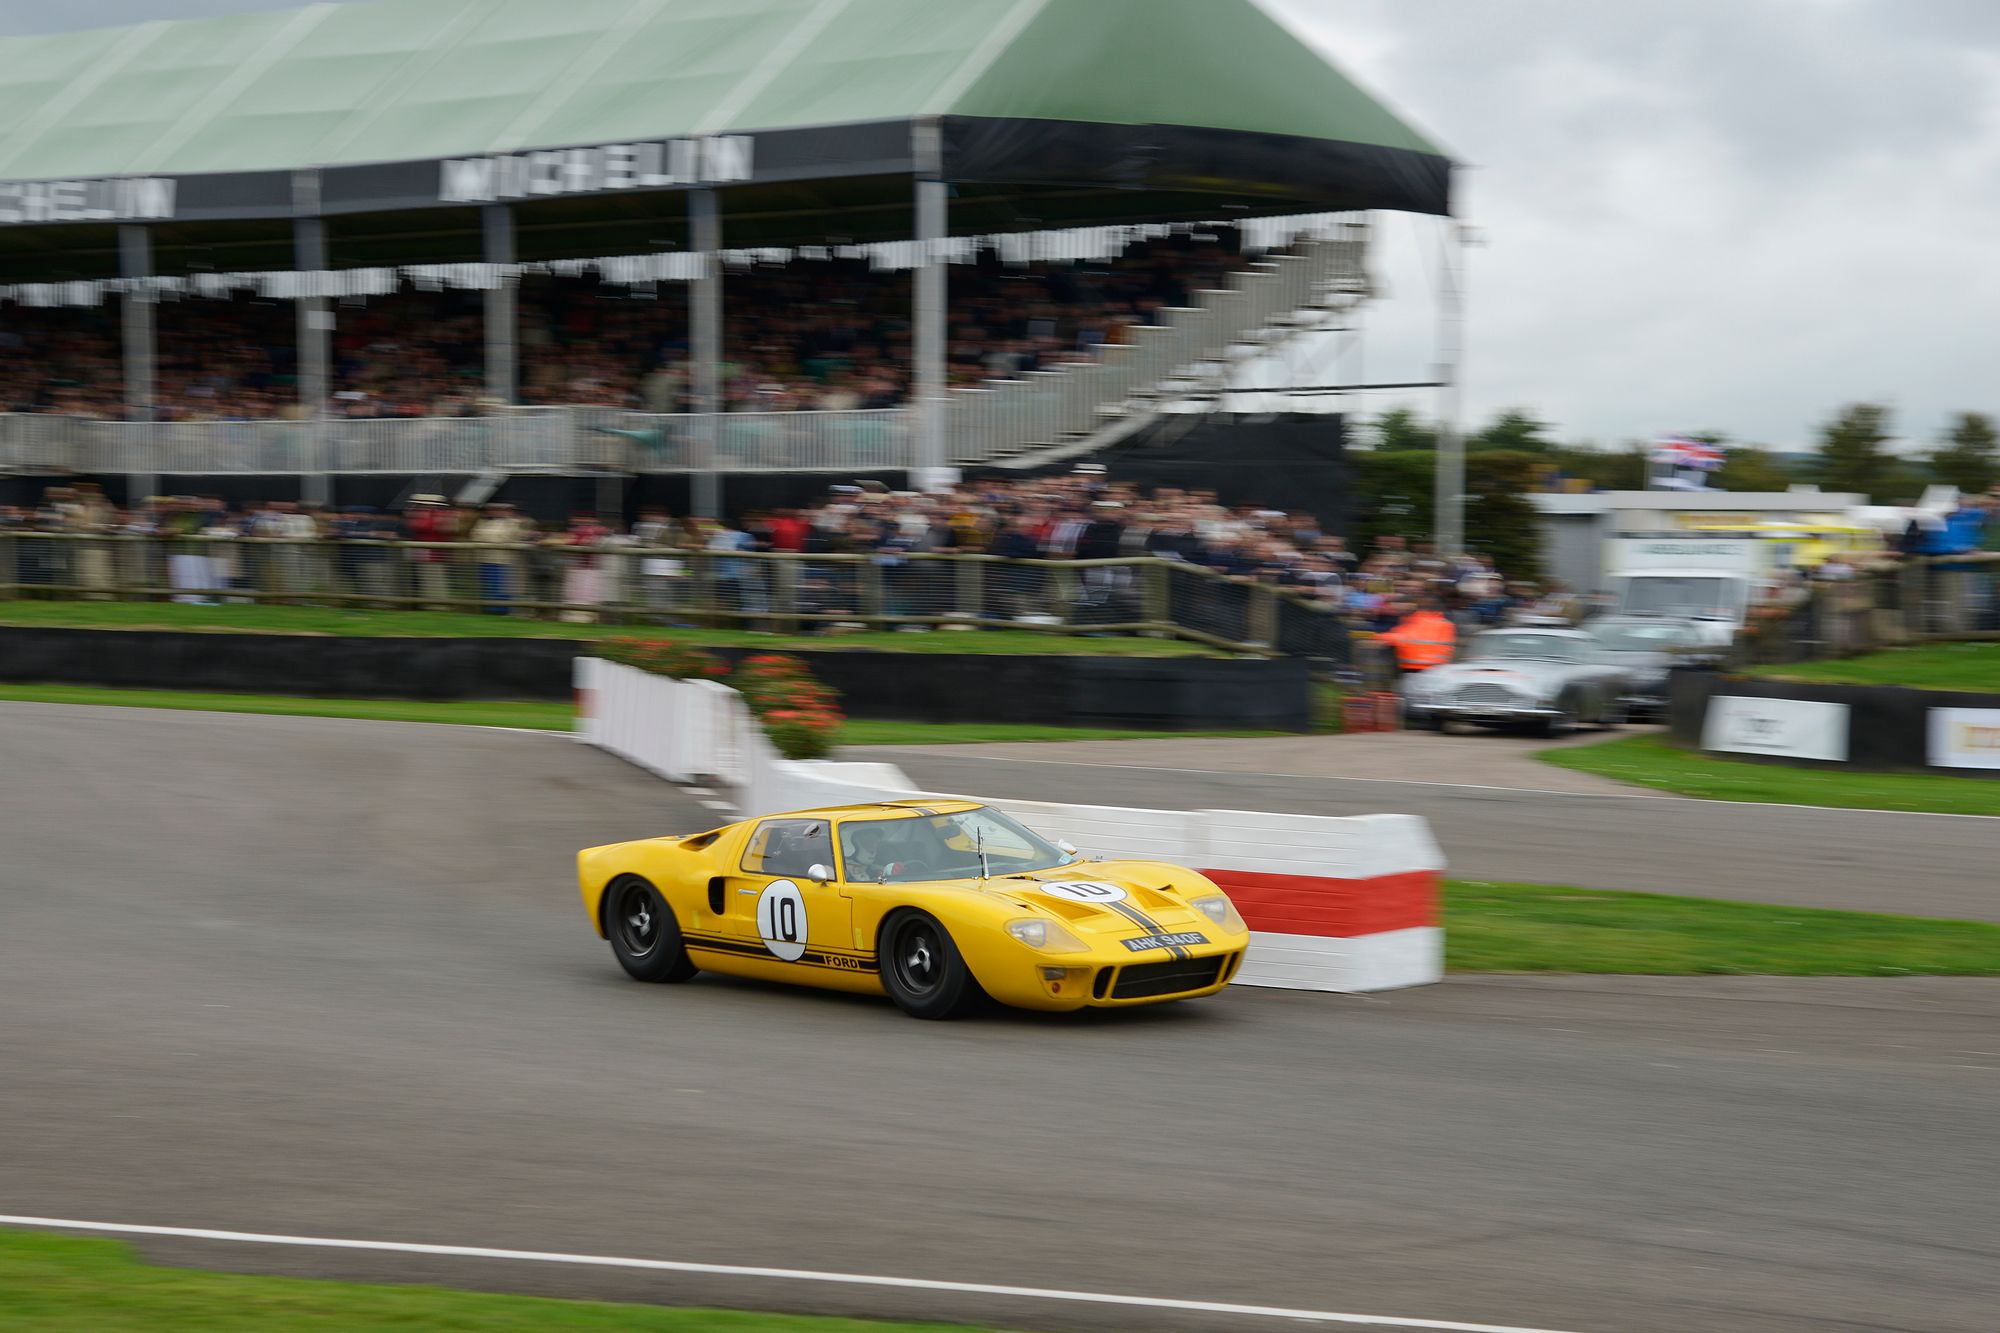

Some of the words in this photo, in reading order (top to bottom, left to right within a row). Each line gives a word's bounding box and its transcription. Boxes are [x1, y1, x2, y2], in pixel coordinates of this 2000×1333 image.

[440, 135, 754, 202] MICHELIN
[1056, 883, 1112, 897] 10
[770, 896, 797, 942] 10
[1127, 936, 1163, 951] AHK
[1161, 933, 1202, 946] 940F
[825, 955, 859, 969] FORD
